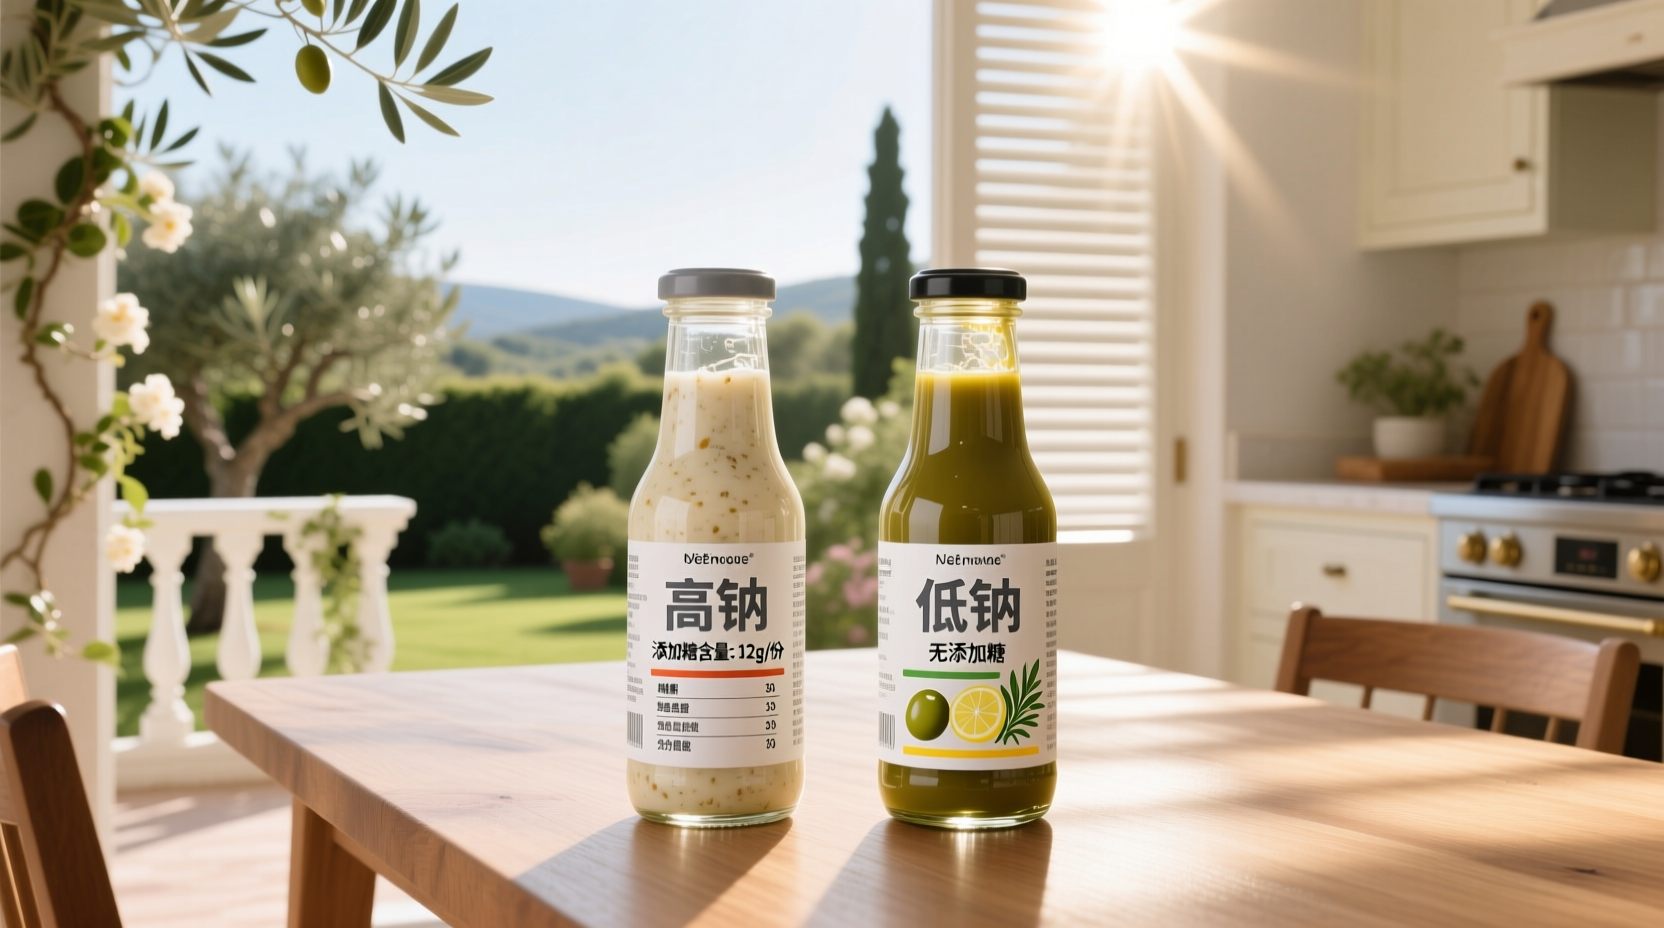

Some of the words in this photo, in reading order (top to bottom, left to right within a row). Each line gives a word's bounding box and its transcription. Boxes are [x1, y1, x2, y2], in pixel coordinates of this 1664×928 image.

[666, 577, 767, 632] 高钠
[916, 578, 1021, 633] 低钠
[929, 642, 1006, 664] 无添加糖
